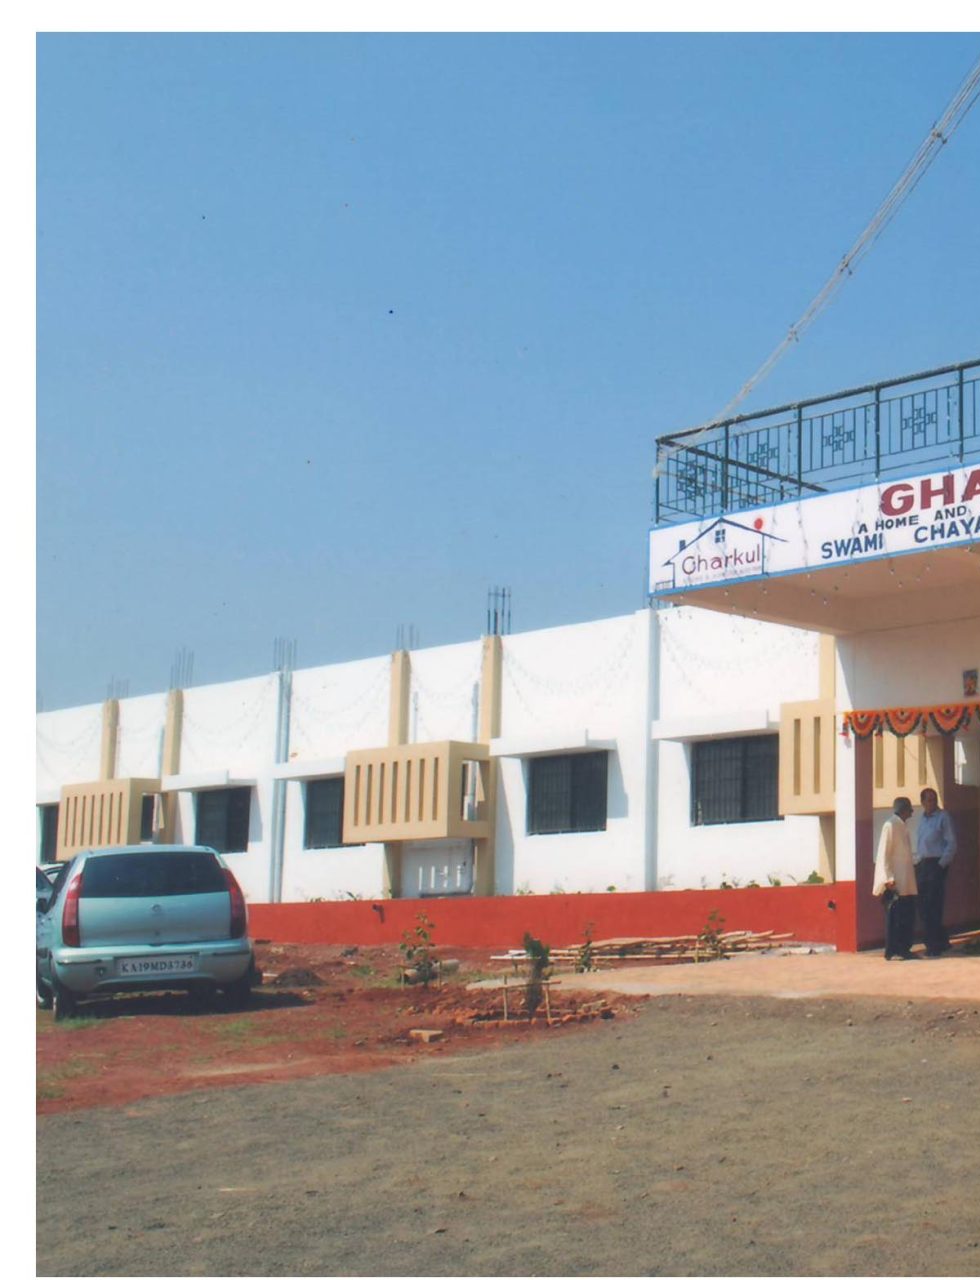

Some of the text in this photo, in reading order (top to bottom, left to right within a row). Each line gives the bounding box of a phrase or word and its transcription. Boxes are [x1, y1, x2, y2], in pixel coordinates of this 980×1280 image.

[875, 514, 919, 531] HOME
[934, 505, 967, 521] AND
[682, 544, 760, 575] Gharkul
[821, 533, 884, 560] SWAMI
